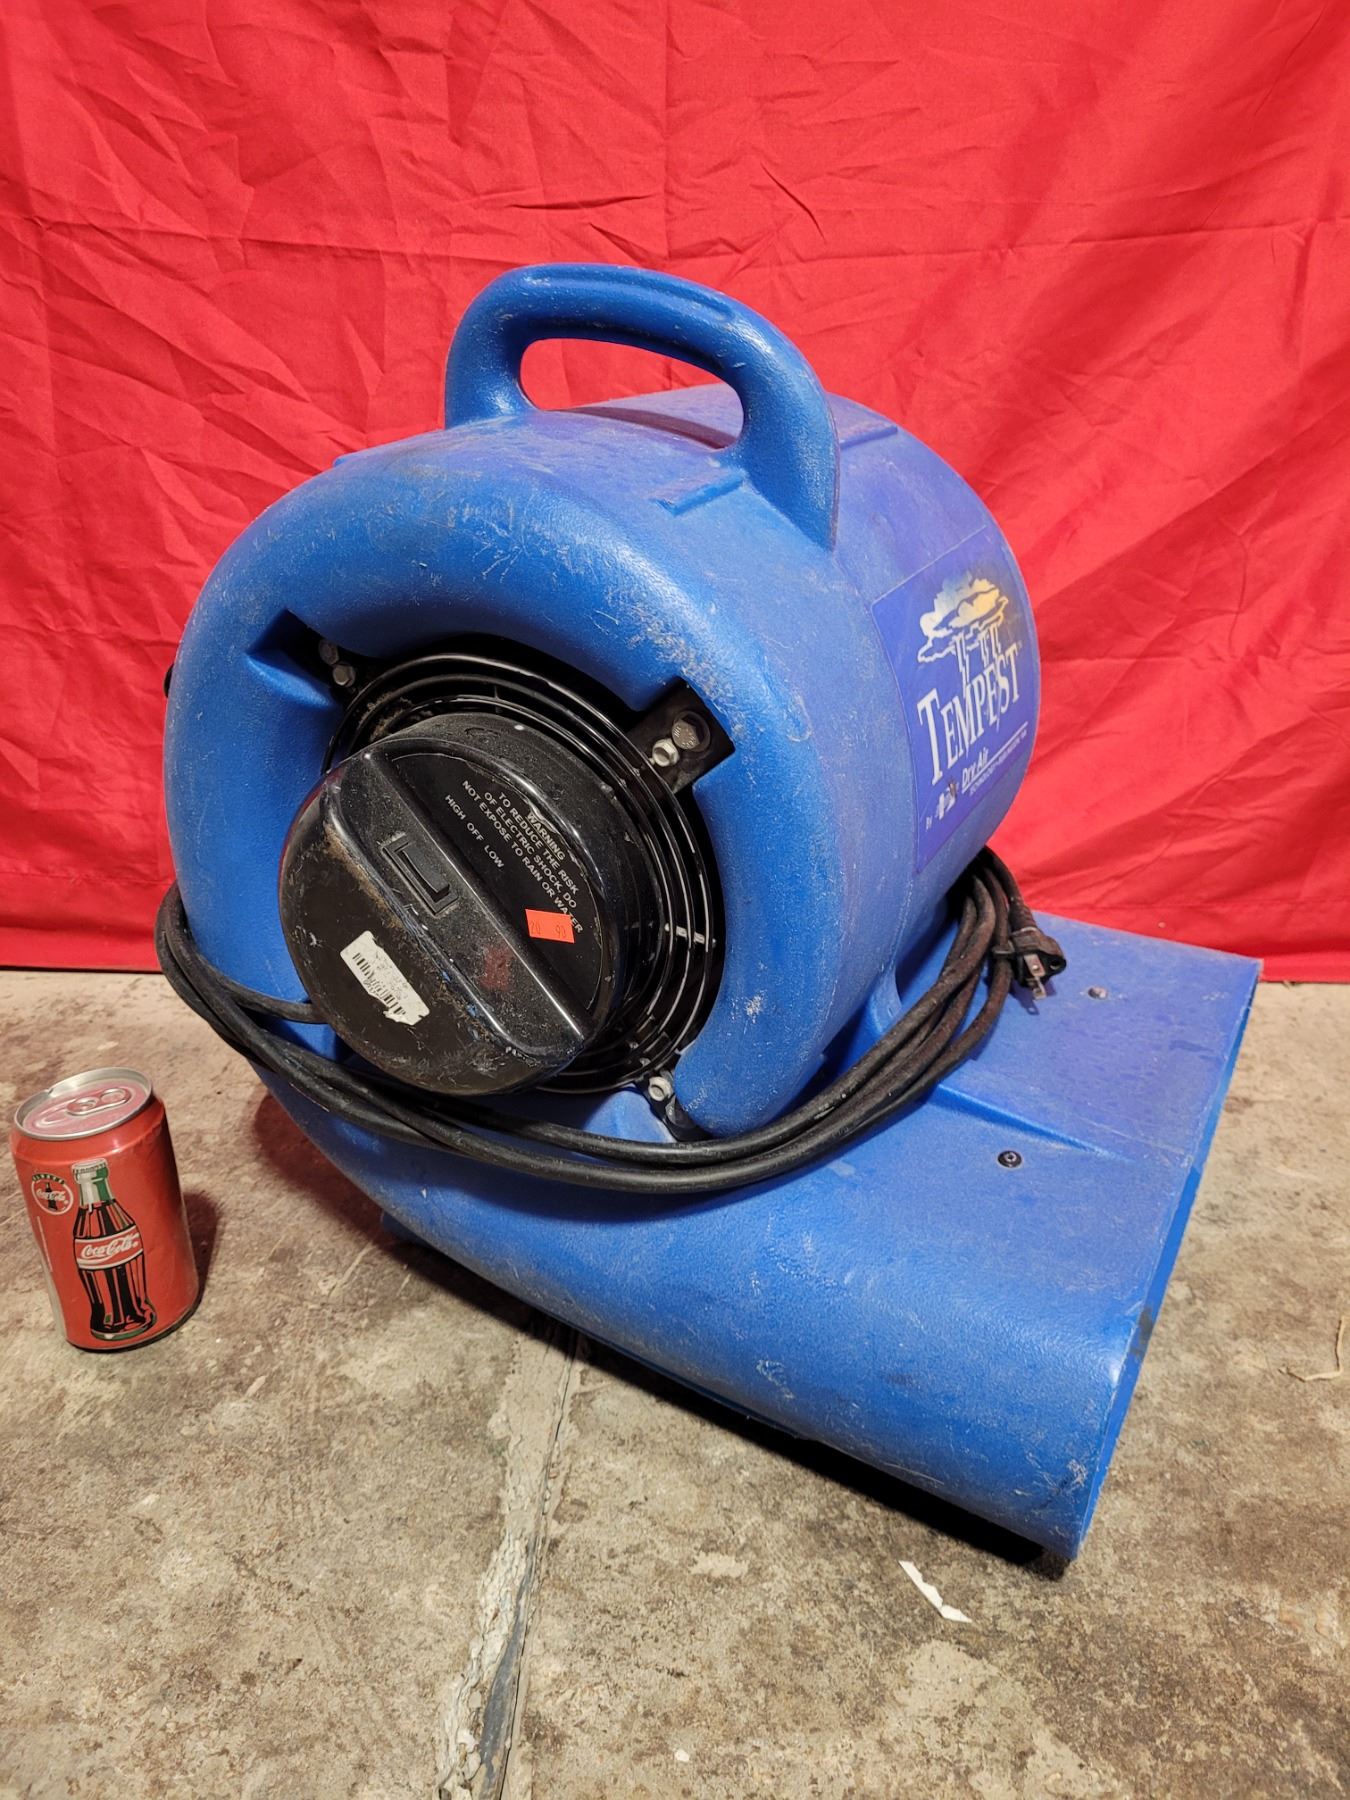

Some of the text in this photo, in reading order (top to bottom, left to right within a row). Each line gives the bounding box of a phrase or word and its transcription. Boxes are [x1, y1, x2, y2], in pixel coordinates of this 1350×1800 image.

[917, 641, 1020, 786] TEMPEST
[445, 794, 505, 868] HIGH OFF LOW
[462, 780, 481, 802] NOT
[479, 802, 512, 842] EXPOSE
[511, 841, 524, 857] TO
[522, 856, 543, 882] RAIN
[541, 881, 556, 898] OR
[484, 792, 577, 908] OF ELECTRIC SHOCK, DO
[499, 792, 579, 895] TO REDUCE THE RISK
[525, 810, 566, 861] WARNING
[81, 1233, 140, 1258] Coca-Cola
